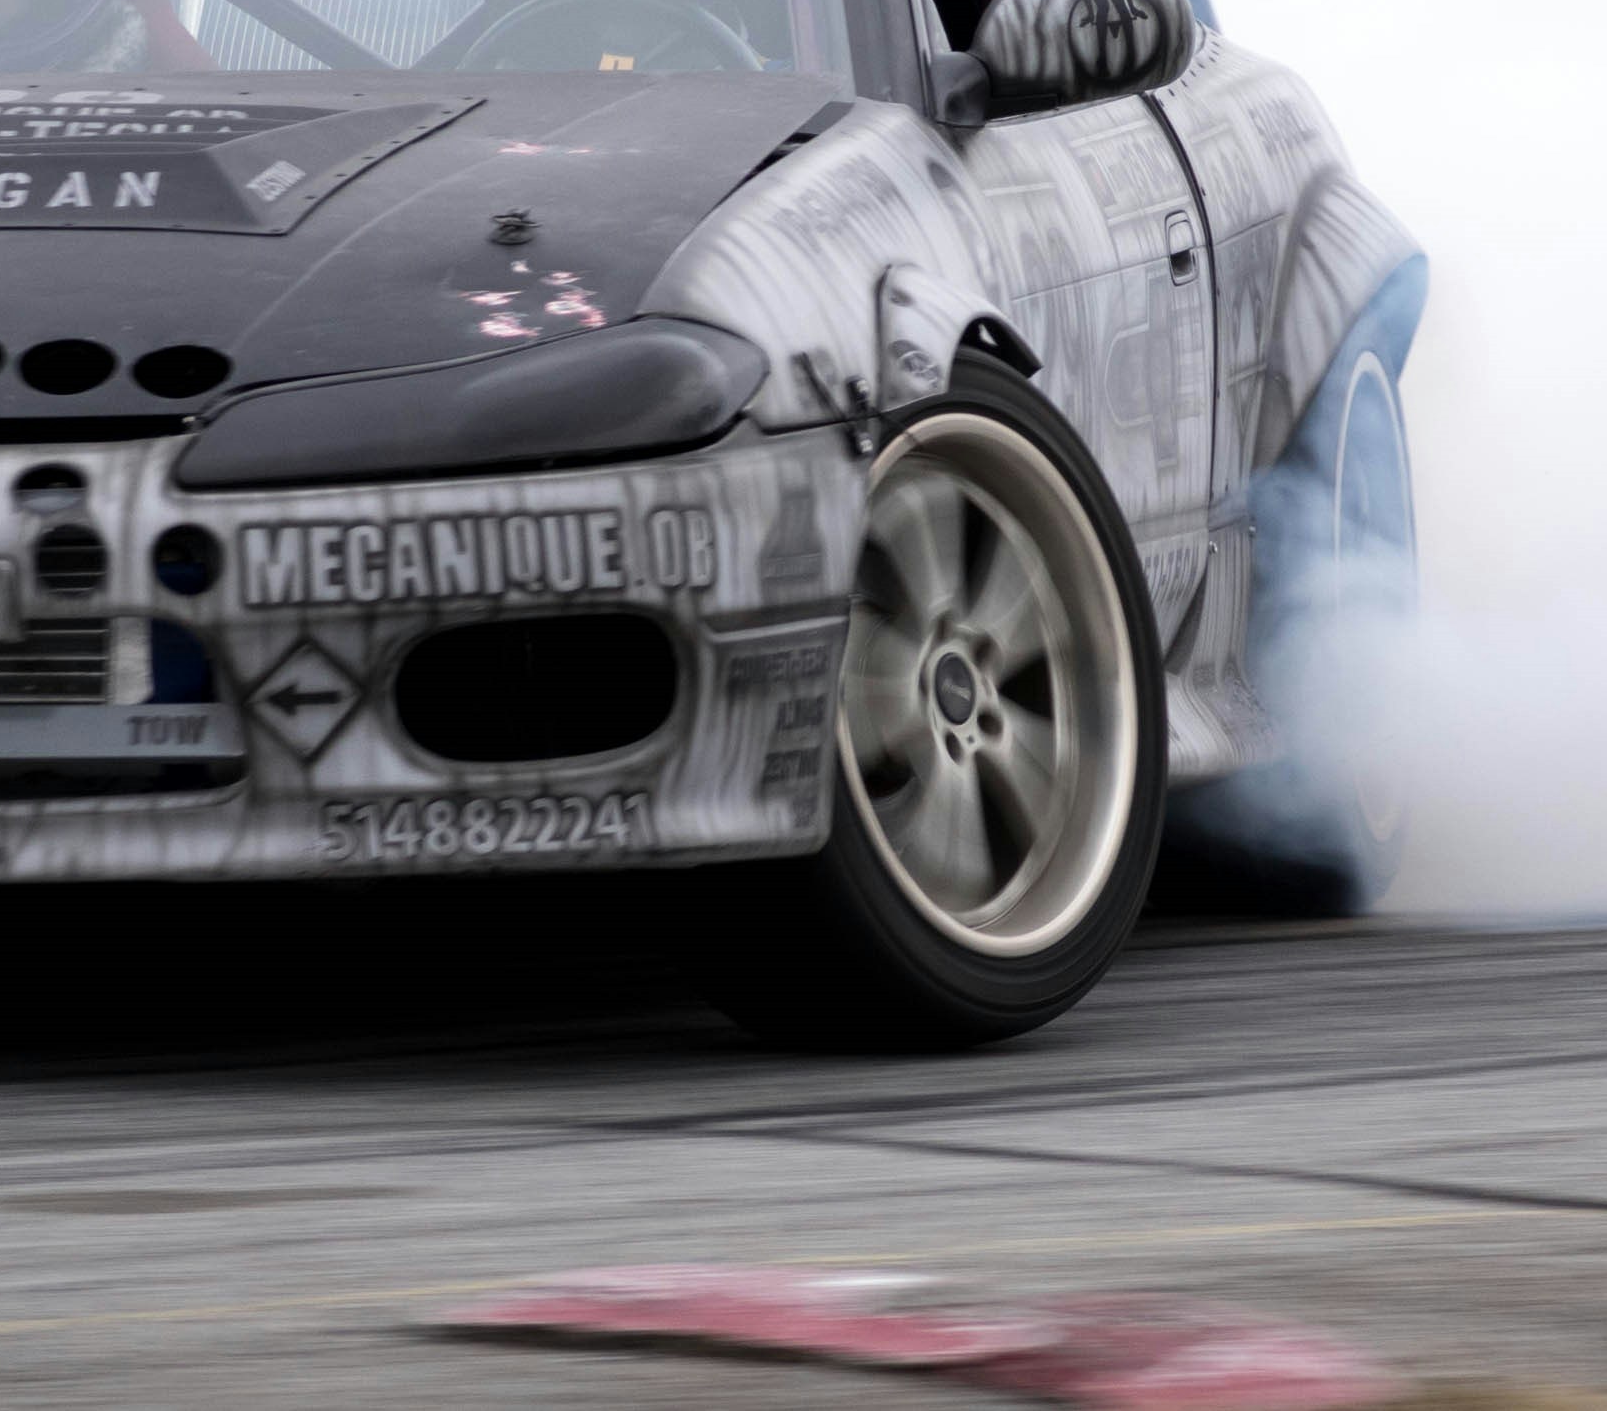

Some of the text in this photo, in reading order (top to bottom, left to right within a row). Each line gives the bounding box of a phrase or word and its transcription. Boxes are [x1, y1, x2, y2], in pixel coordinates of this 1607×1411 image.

[243, 508, 623, 605] MECANIQUE
[126, 715, 208, 746] TOW
[319, 792, 657, 861] 5148822241
